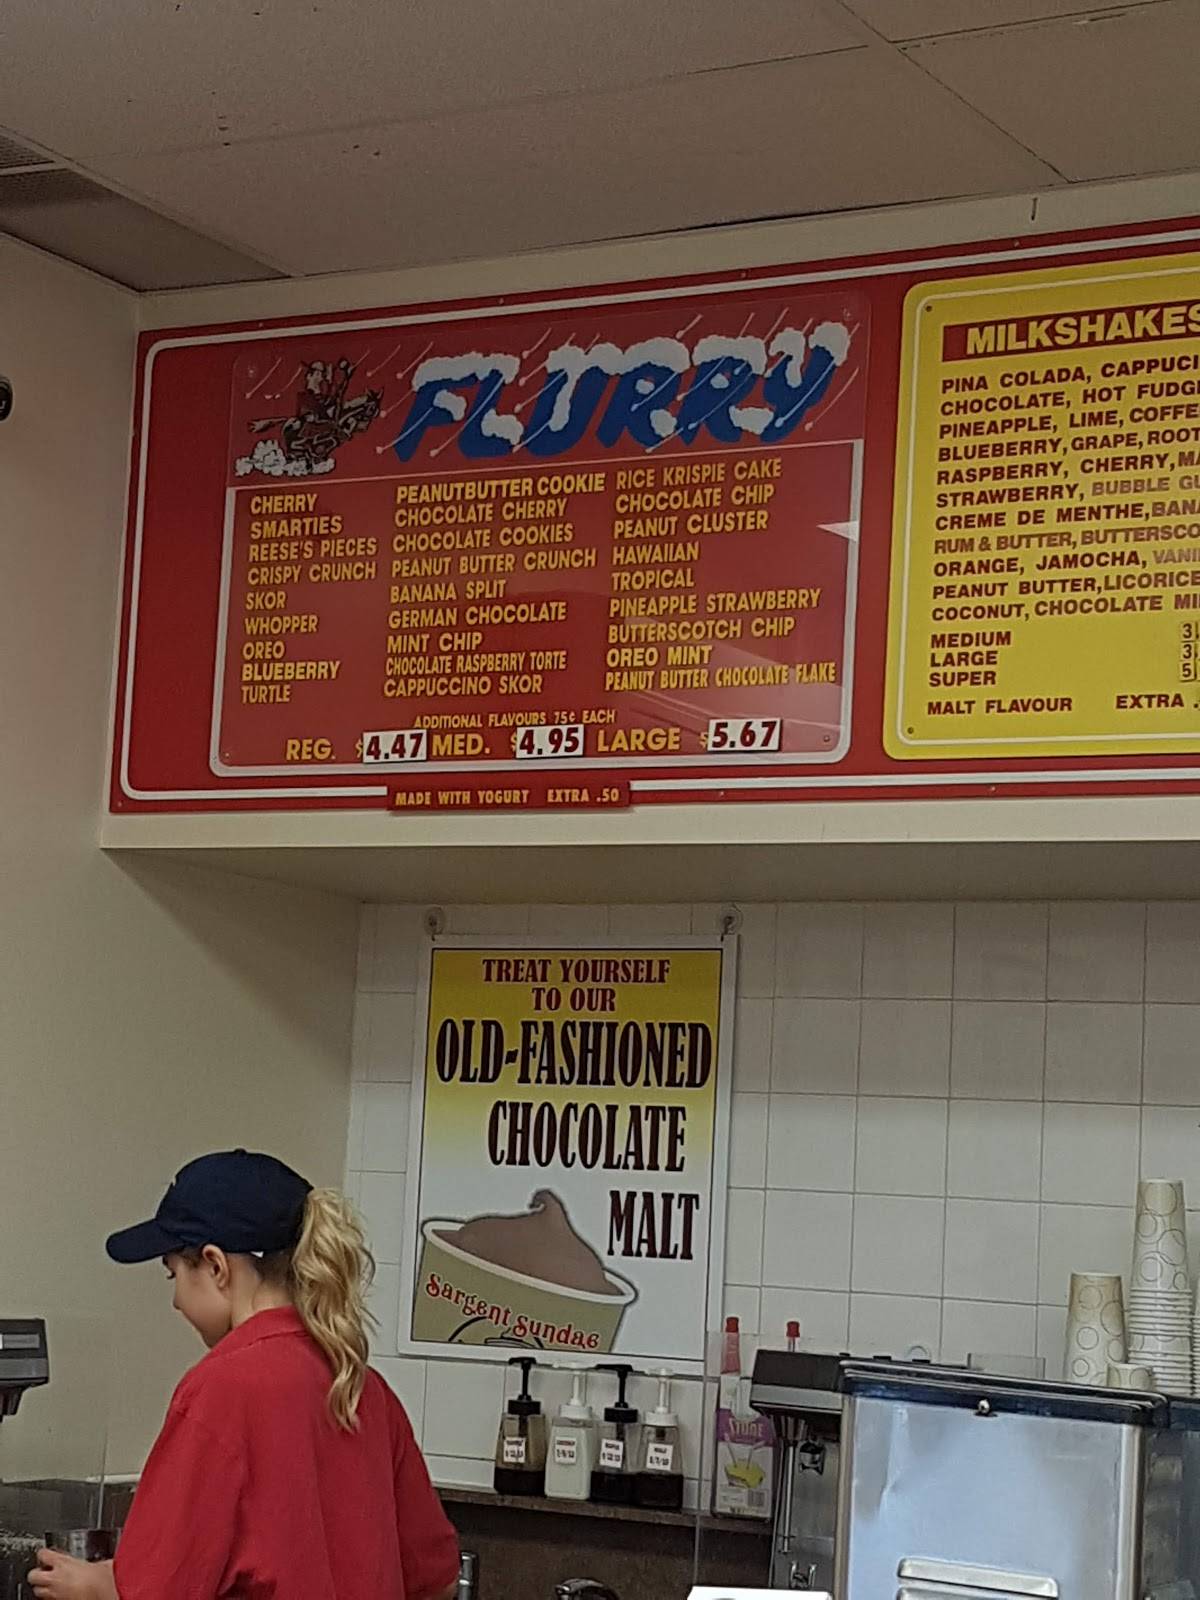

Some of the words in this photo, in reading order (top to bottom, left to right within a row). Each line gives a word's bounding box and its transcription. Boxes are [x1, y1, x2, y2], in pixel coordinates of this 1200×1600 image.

[395, 322, 851, 462] FLURRY
[942, 376, 989, 394] PINA
[1000, 366, 1092, 388] COLADA,
[940, 392, 1071, 416] CHOCOLATE,
[1082, 386, 1126, 404] HOT
[1136, 380, 1200, 400] FUDG
[939, 415, 1058, 440] PINEAPPLE,
[1069, 410, 1124, 428] LIME,
[938, 438, 1068, 462] BLUEBERRY,
[1070, 432, 1144, 451] GRAPE,
[616, 468, 655, 490] RICE
[663, 462, 726, 486] KRISPIE
[734, 458, 782, 480] CAKE
[936, 462, 1069, 486] RASPBERRY,
[1080, 453, 1175, 474] CHERRY,
[396, 478, 532, 504] PEANUTBUTTER
[537, 472, 606, 496] COOKIE
[615, 487, 722, 514] CHOCOLATE
[731, 483, 775, 506] CHIP
[936, 484, 1085, 508] STRAWBERRY,
[1092, 478, 1170, 496] BUBBLE
[250, 494, 317, 514] CHERRY
[395, 503, 493, 527] CHOCOLATE
[502, 498, 567, 520] CHERRY
[936, 512, 1006, 531] CREME
[1017, 510, 1045, 525] DE
[1056, 502, 1150, 524] MENTHE,
[1152, 500, 1200, 517] BAN
[250, 515, 342, 540] SMARTIES
[392, 529, 490, 553] CHOCOLATE
[500, 523, 574, 546] COOKIES
[614, 515, 678, 540] PEANUT
[686, 510, 768, 534] CLUSTER
[249, 540, 313, 562] REESE'S
[320, 537, 377, 557] PIECES
[612, 541, 700, 566] HAWAIIAN
[934, 538, 975, 554] RUM
[978, 536, 992, 551] &
[996, 532, 1077, 550] BUTTER,
[248, 565, 301, 585] CRISPY
[309, 561, 376, 582] CRUNCH
[391, 556, 451, 578] PEANUT
[459, 553, 515, 574] BUTTER
[524, 548, 596, 570] CRUNCH
[934, 558, 1024, 577] ORANGE,
[1036, 551, 1148, 571] JAMOCHA,
[390, 582, 456, 604] BANANA
[466, 580, 506, 600] SPLIT
[612, 568, 695, 591] TROPICAL
[932, 582, 1008, 600] PEANUT
[1018, 578, 1102, 596] BUTTER,
[1104, 571, 1200, 591] LICORICE
[246, 591, 286, 610] SKOR
[609, 595, 697, 618] PINEAPPLE
[706, 588, 822, 613] STRAWBERRY
[932, 604, 1030, 622] COCONUT,
[1034, 595, 1162, 616] CHOCOLATE
[245, 615, 318, 635] WHOPPER
[388, 607, 458, 629] GERMAN
[465, 602, 566, 624] CHOCOLATE
[387, 634, 430, 654] MINT
[439, 632, 482, 651] CHIP
[608, 619, 742, 644] BUTTERSCOTCH
[751, 616, 796, 638] CHIP
[931, 631, 1012, 649] MEDIUM
[243, 640, 285, 660] OREO
[386, 655, 452, 676] CHOCOLATE
[456, 652, 525, 673] RASPBERRY
[530, 650, 567, 670] TORTE
[606, 647, 658, 668] OREO
[668, 645, 713, 665] MINT
[930, 651, 998, 667] LARGE
[242, 661, 340, 681] BLUEBERRY
[604, 669, 655, 691] PEANUT
[660, 668, 708, 689] BUTTER
[715, 664, 788, 687] CHOCOLATE
[796, 662, 836, 683] FLAKE
[929, 670, 996, 687] SUPER
[241, 684, 291, 703] TURTLE
[384, 676, 492, 697] CAPPUCCINO
[499, 674, 542, 694] SKOR
[928, 700, 976, 715] MALT
[985, 698, 1073, 714] FLAVOUR
[1116, 694, 1184, 710] EXTRA
[414, 715, 482, 729] ADDITIONAL
[488, 712, 546, 726] FLAVOURS
[554, 711, 576, 724] 75¢
[582, 709, 616, 724] EACH
[286, 738, 336, 760] REG.
[432, 732, 490, 756] MED.
[598, 728, 680, 752] LARGE
[395, 792, 431, 806] MADE
[438, 790, 470, 804] WITH
[478, 789, 530, 804] YOGURT
[548, 789, 589, 802] EXTRA
[596, 788, 619, 802] .50
[482, 959, 552, 984] TREAT
[560, 959, 671, 984] YOURSELF
[532, 988, 562, 1012] TO
[570, 988, 616, 1012] OUR
[436, 1018, 712, 1089] OLD-FASHIONED
[488, 1100, 687, 1172] CHOCOLATE
[607, 1190, 700, 1261] MALT
[426, 1274, 512, 1326] Sargent
[512, 1315, 600, 1349] Sundae
